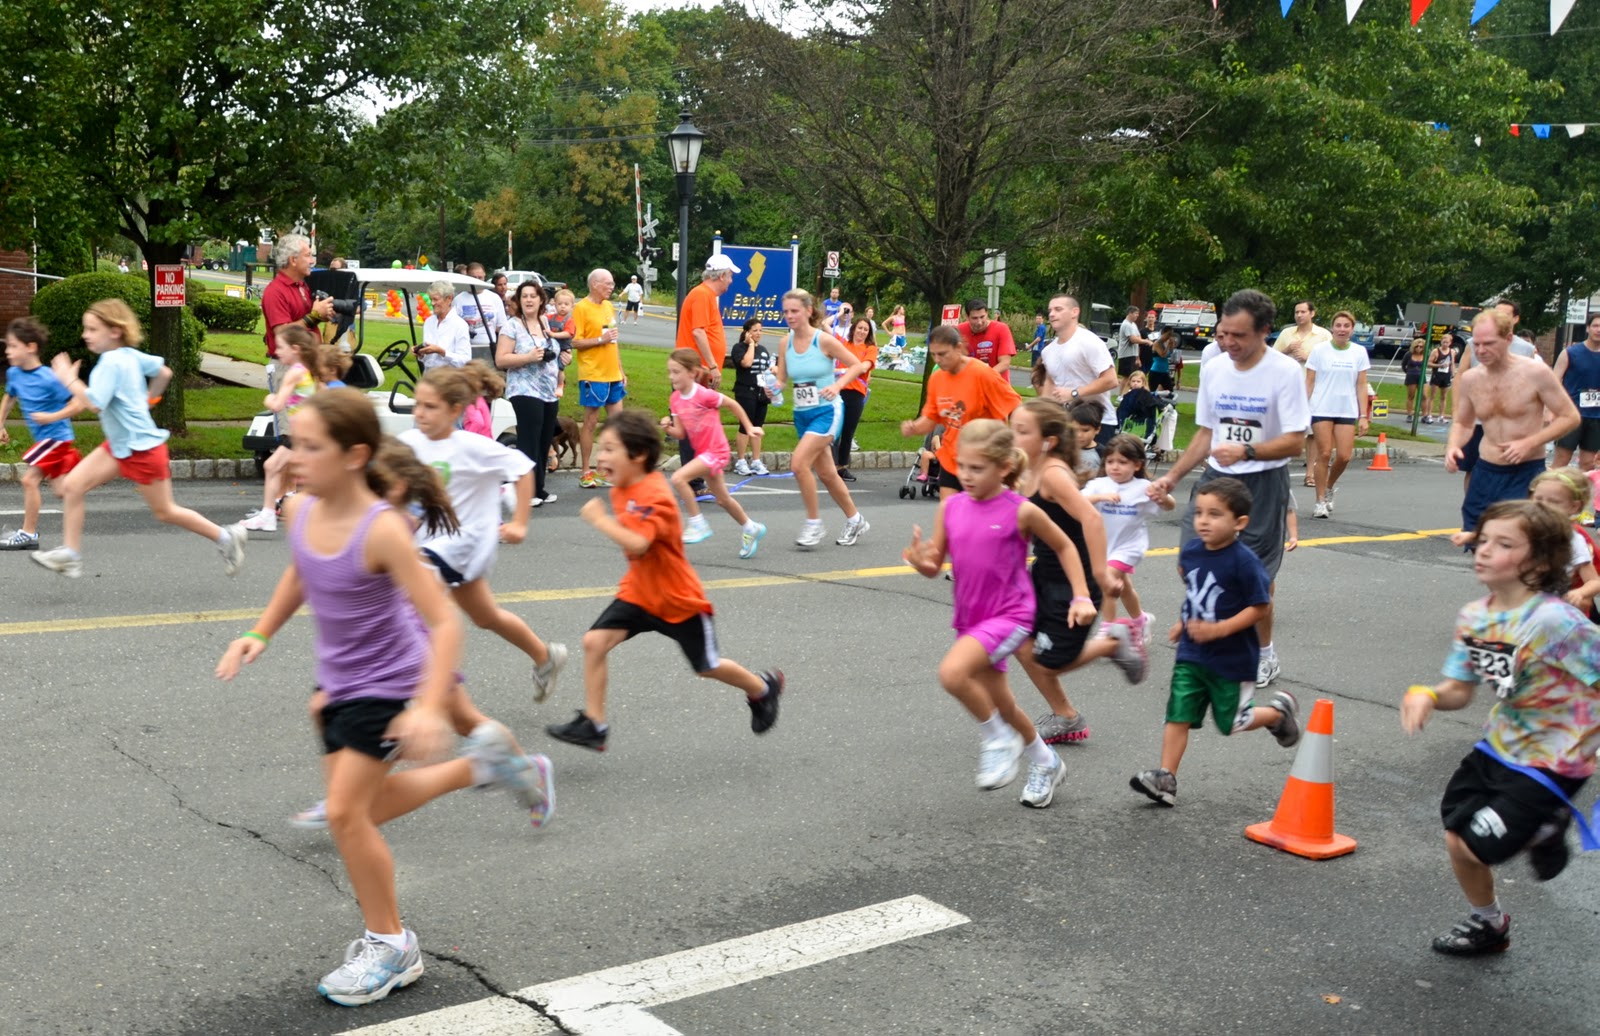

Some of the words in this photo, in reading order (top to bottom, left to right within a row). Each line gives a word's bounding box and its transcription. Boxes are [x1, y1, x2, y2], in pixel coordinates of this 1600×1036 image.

[165, 272, 175, 283] NO
[156, 284, 184, 295] PARKING
[733, 293, 762, 307] Bank
[764, 294, 777, 307] of
[722, 307, 747, 320] New
[750, 308, 785, 324] Jersey
[947, 310, 955, 318] NO
[796, 388, 814, 399] 604
[1226, 427, 1252, 442] 140
